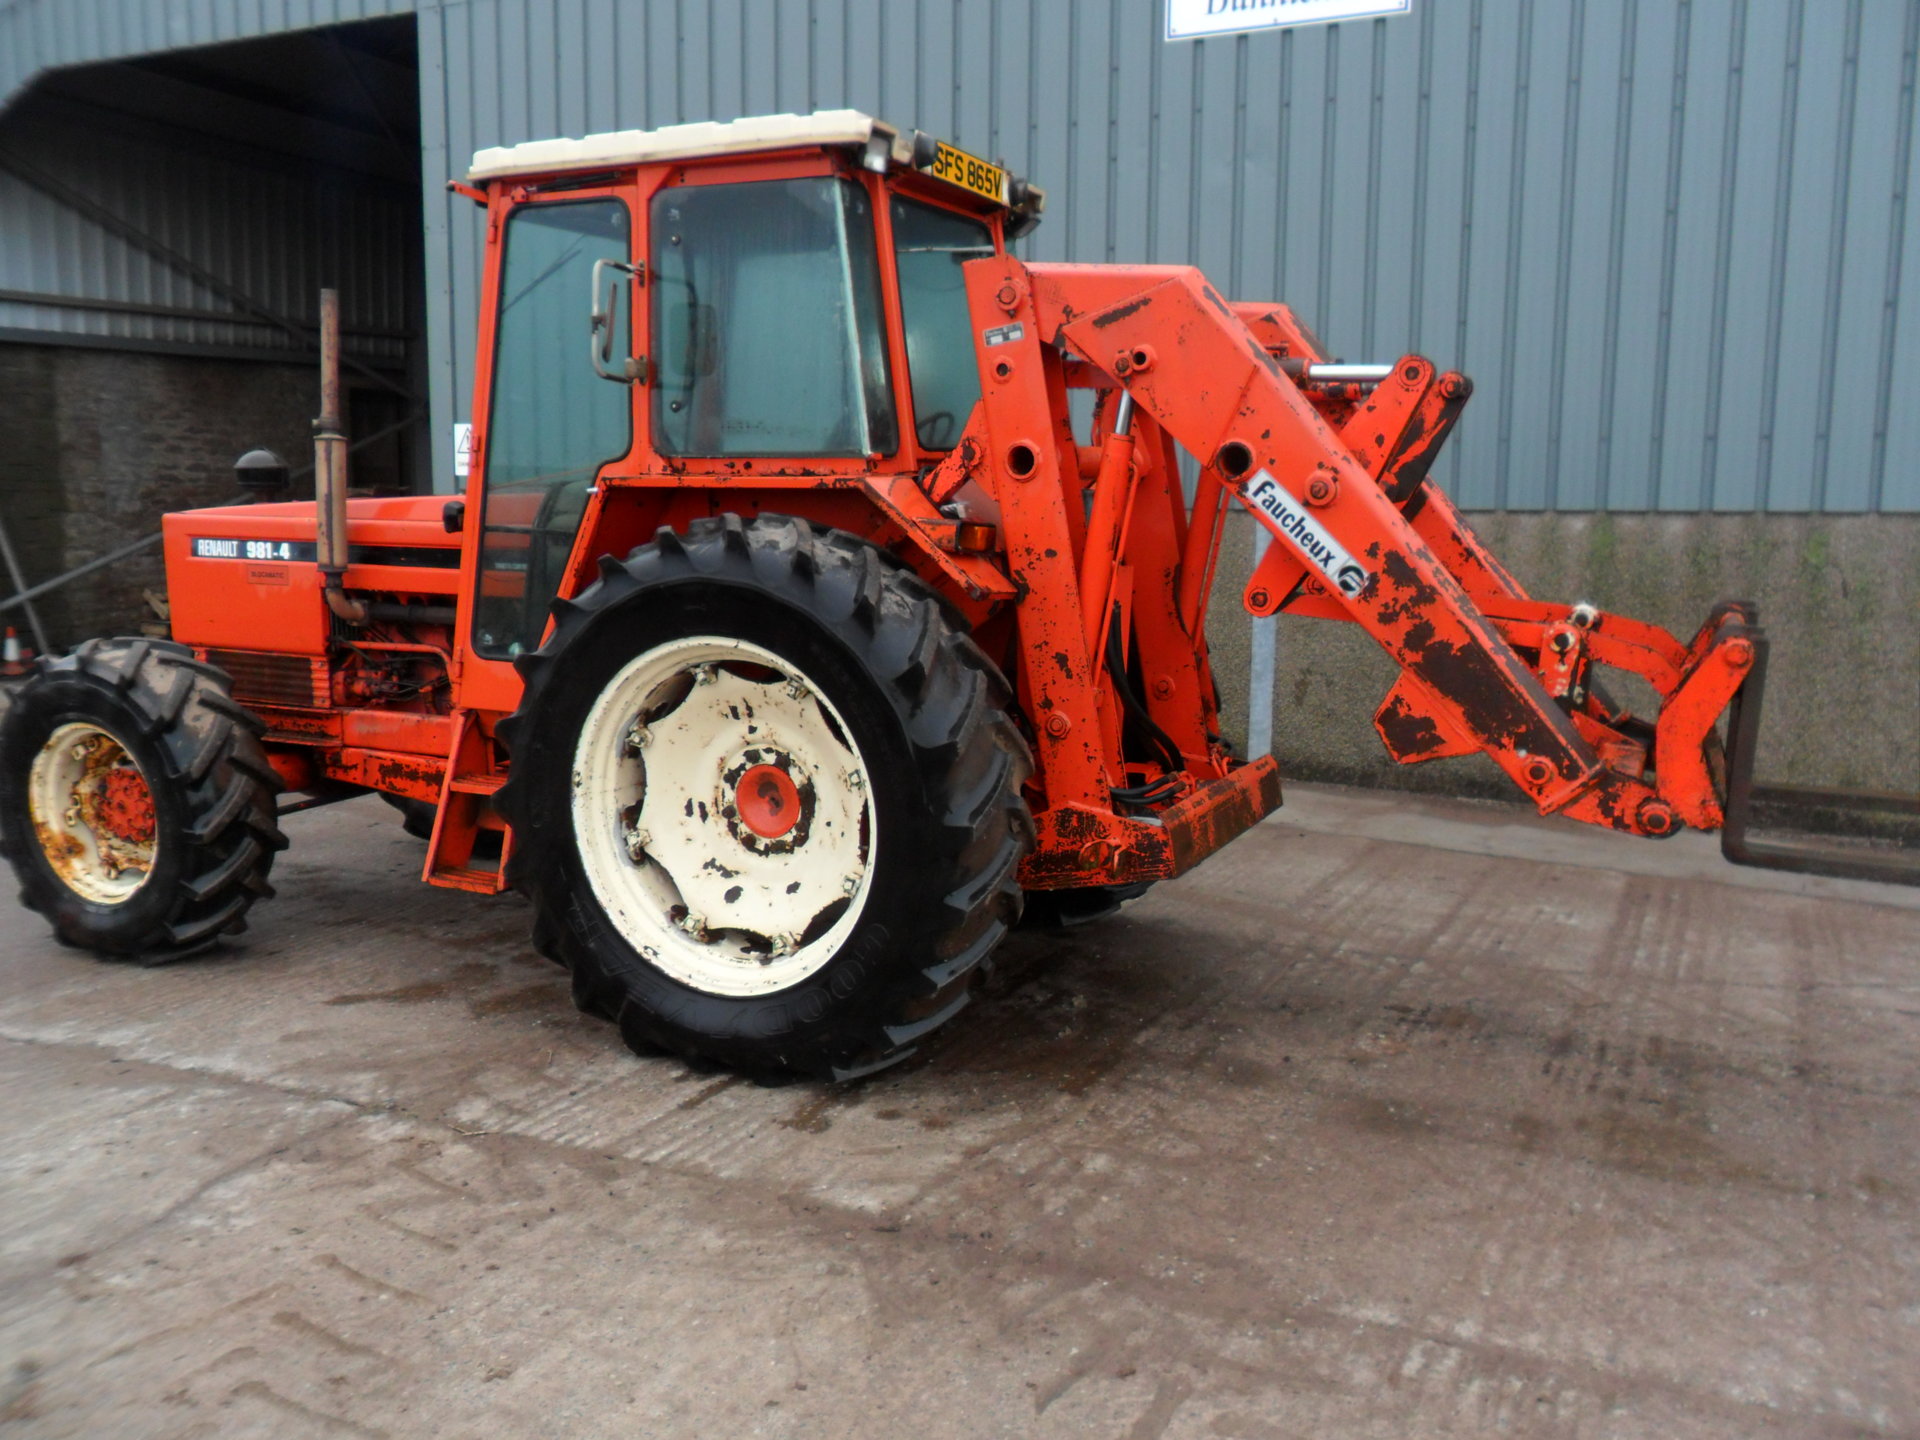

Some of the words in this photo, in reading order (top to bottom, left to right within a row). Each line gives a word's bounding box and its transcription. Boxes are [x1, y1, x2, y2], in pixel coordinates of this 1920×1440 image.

[934, 146, 963, 182] SFS
[967, 160, 1002, 198] 865V
[198, 539, 238, 556] RENAULT
[246, 541, 290, 559] 981-4
[1252, 480, 1336, 568] Faucheux
